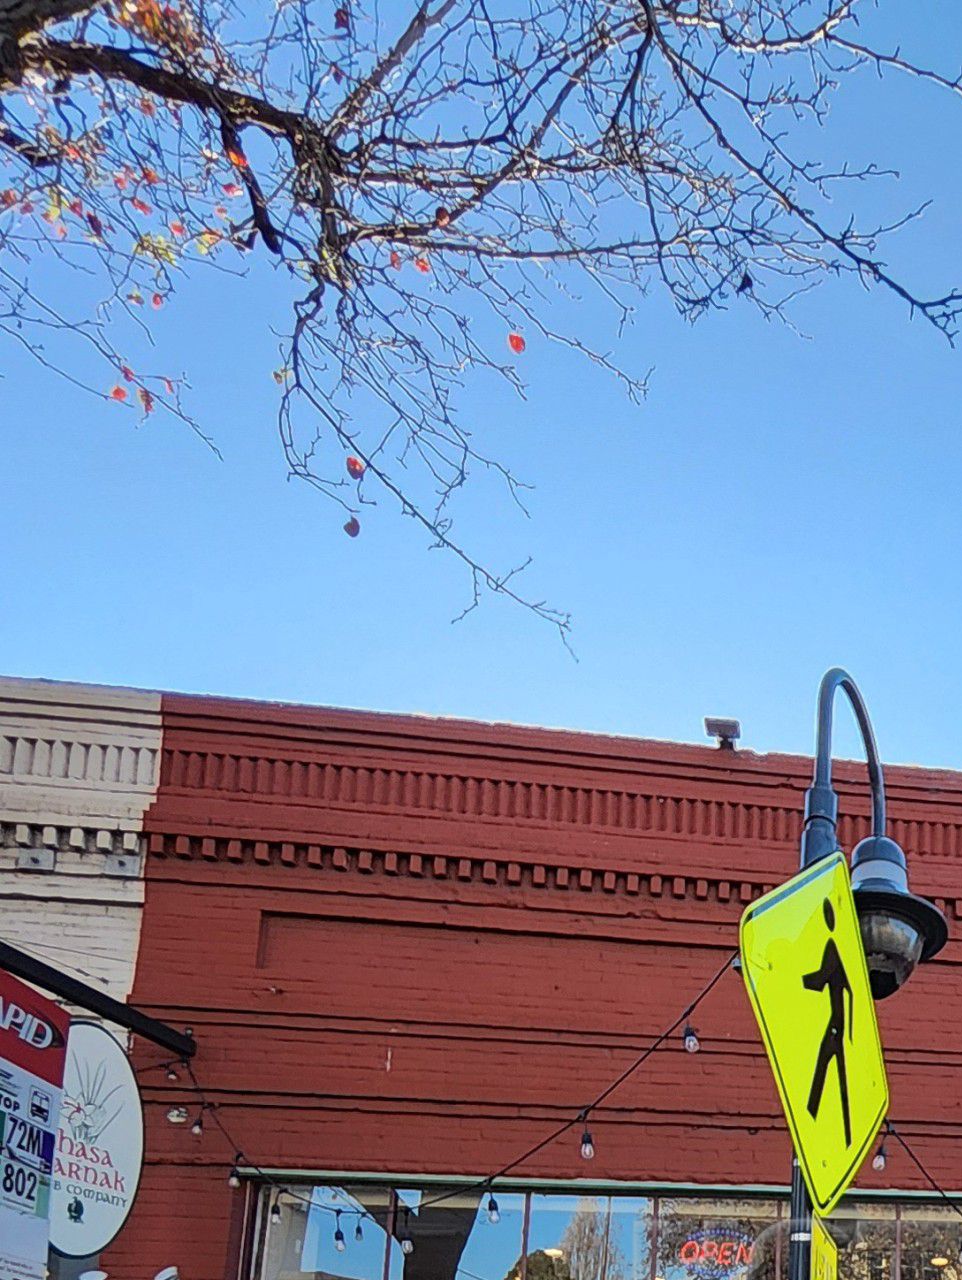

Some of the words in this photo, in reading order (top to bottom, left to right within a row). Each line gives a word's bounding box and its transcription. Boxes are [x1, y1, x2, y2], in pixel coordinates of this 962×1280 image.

[7, 1116, 42, 1157] 72M
[2, 1163, 37, 1201] 802
[679, 1240, 756, 1265] OPEN
